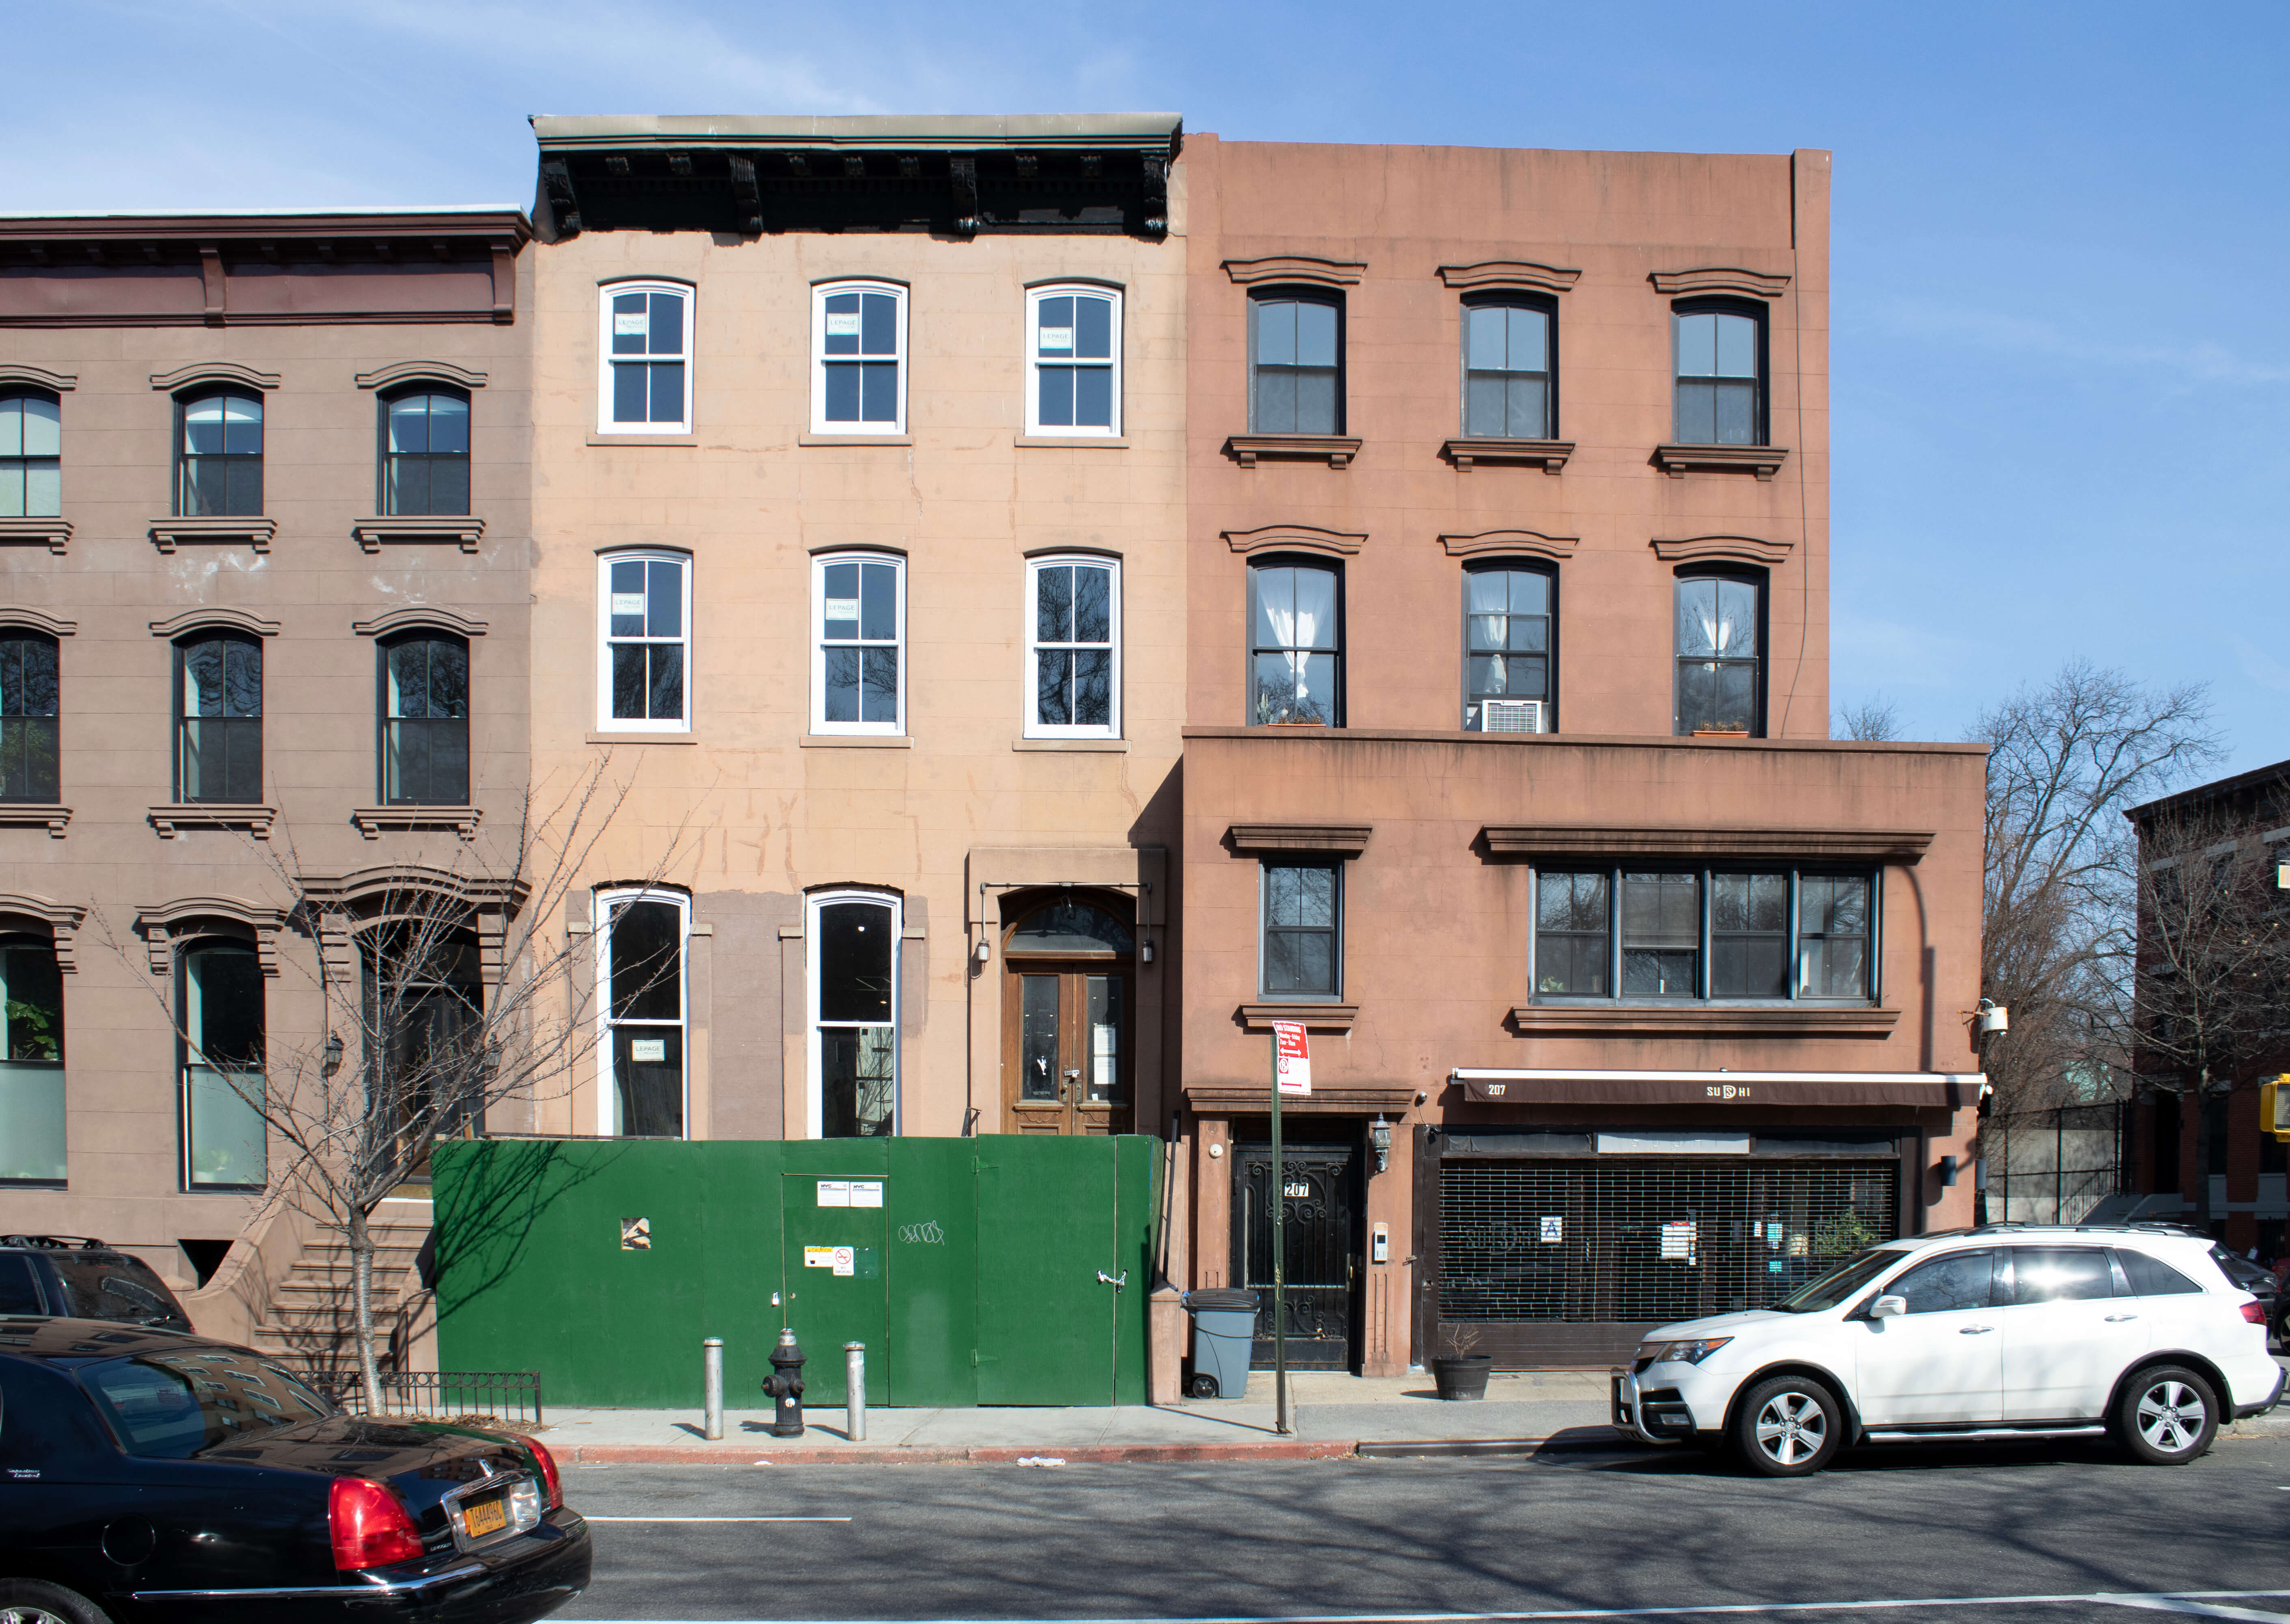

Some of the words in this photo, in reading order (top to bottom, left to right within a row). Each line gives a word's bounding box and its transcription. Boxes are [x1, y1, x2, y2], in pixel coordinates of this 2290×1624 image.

[1283, 1025, 1301, 1033] STANDING
[1489, 1084, 1506, 1095] 207
[1286, 1183, 1307, 1196] 207
[1545, 1221, 1558, 1236] A
[470, 1500, 502, 1528] T644496C
